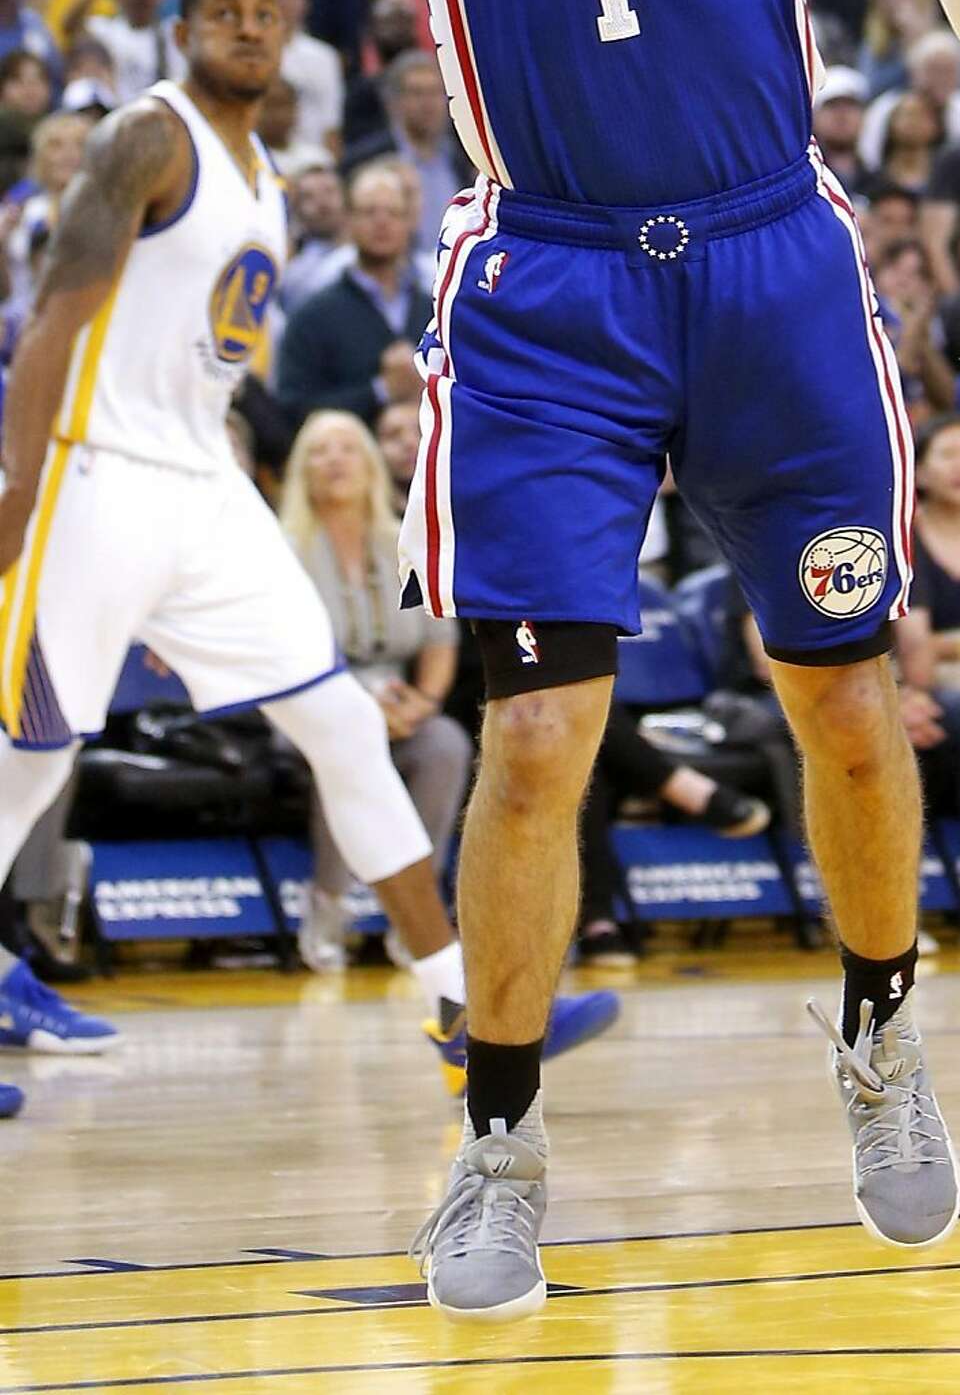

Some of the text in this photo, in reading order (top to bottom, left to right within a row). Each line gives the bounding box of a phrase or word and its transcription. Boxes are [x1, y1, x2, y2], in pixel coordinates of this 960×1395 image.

[810, 562, 884, 597] 76ers
[95, 877, 262, 899] AMERICAN
[97, 899, 242, 921] EXPRESS
